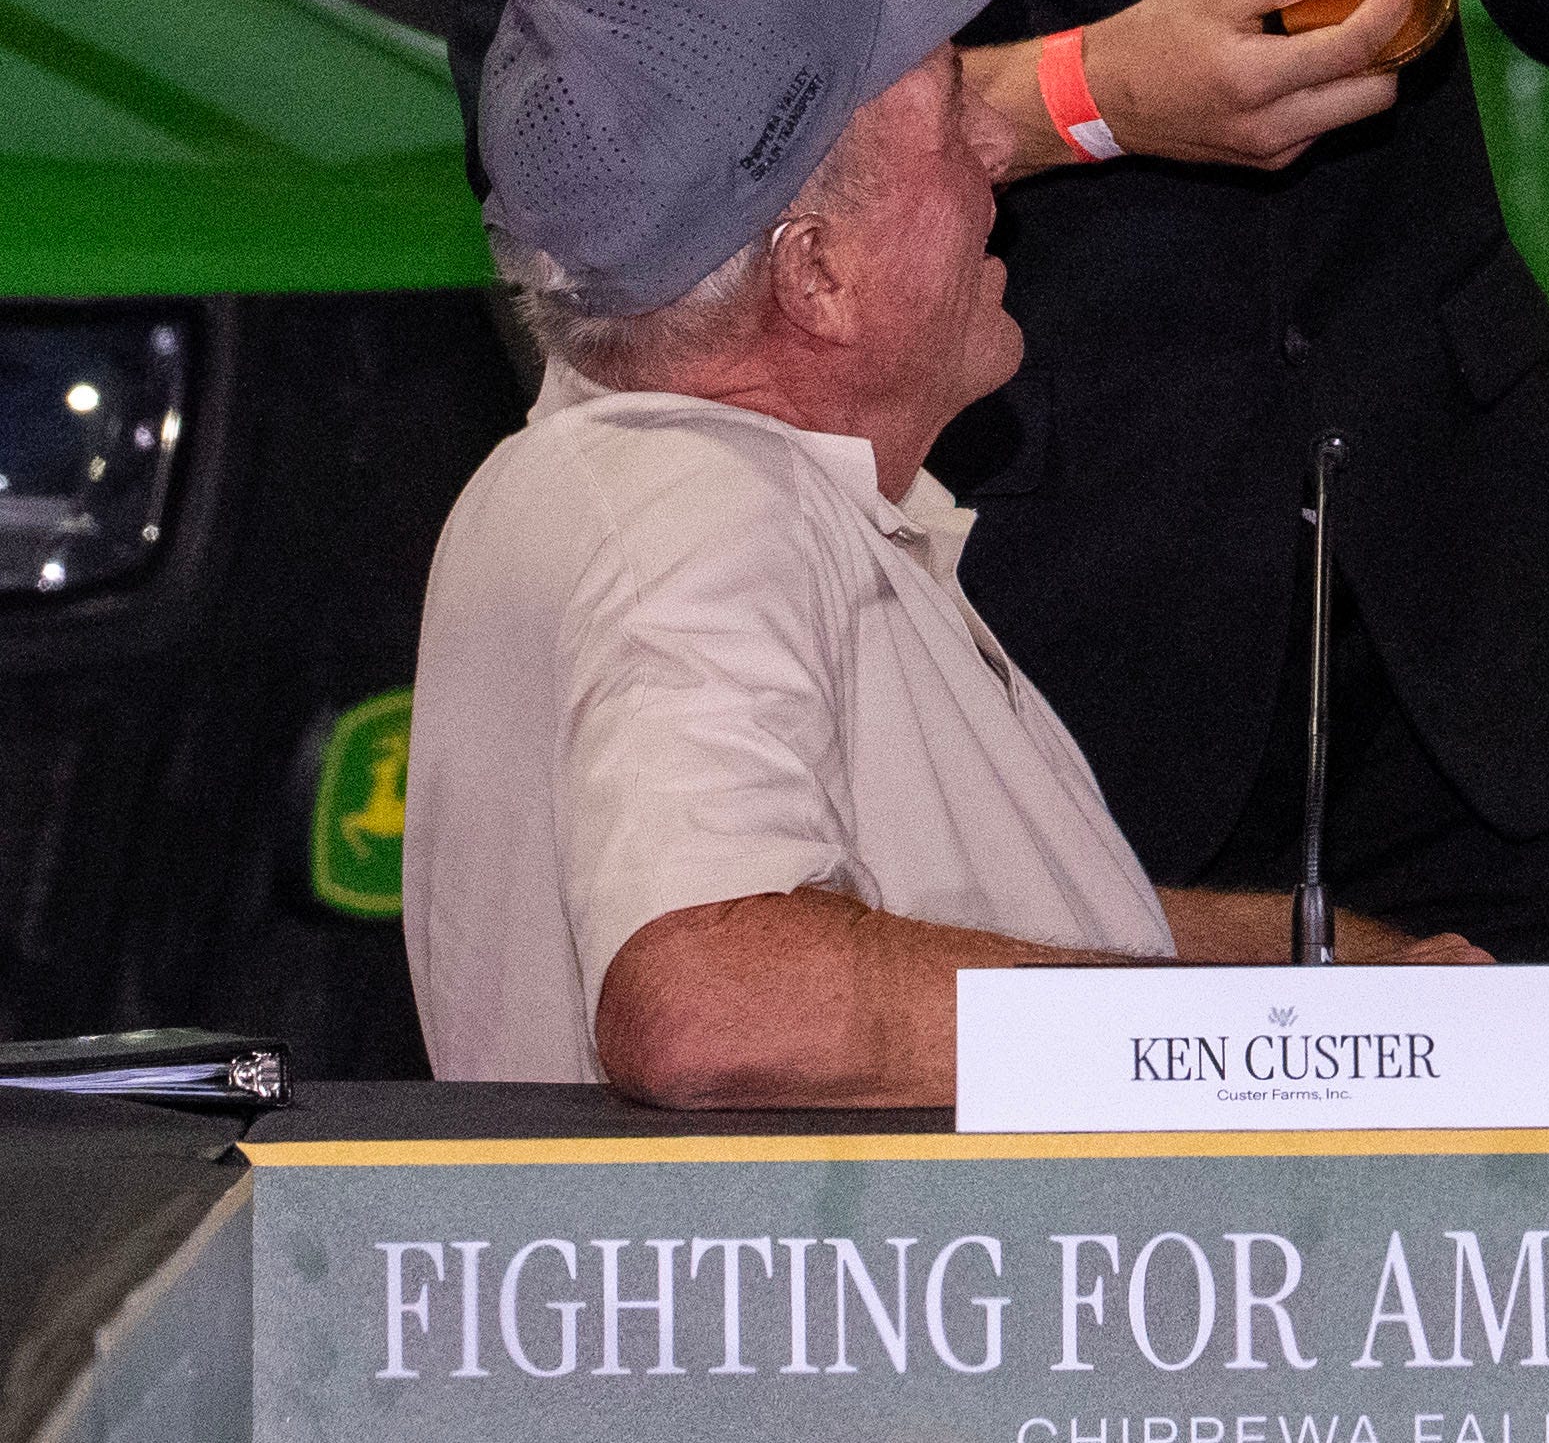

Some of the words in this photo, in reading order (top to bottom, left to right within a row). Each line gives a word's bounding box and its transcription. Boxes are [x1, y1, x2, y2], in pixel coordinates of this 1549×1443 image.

[1130, 1035, 1230, 1081] KEN
[1244, 1033, 1441, 1080] CUSTER
[1216, 1088, 1268, 1101] Custer
[1271, 1087, 1323, 1102] Farms,
[1325, 1087, 1352, 1101] Inc.
[376, 1235, 1012, 1380] FIGHTING
[1049, 1232, 1319, 1373] FOR
